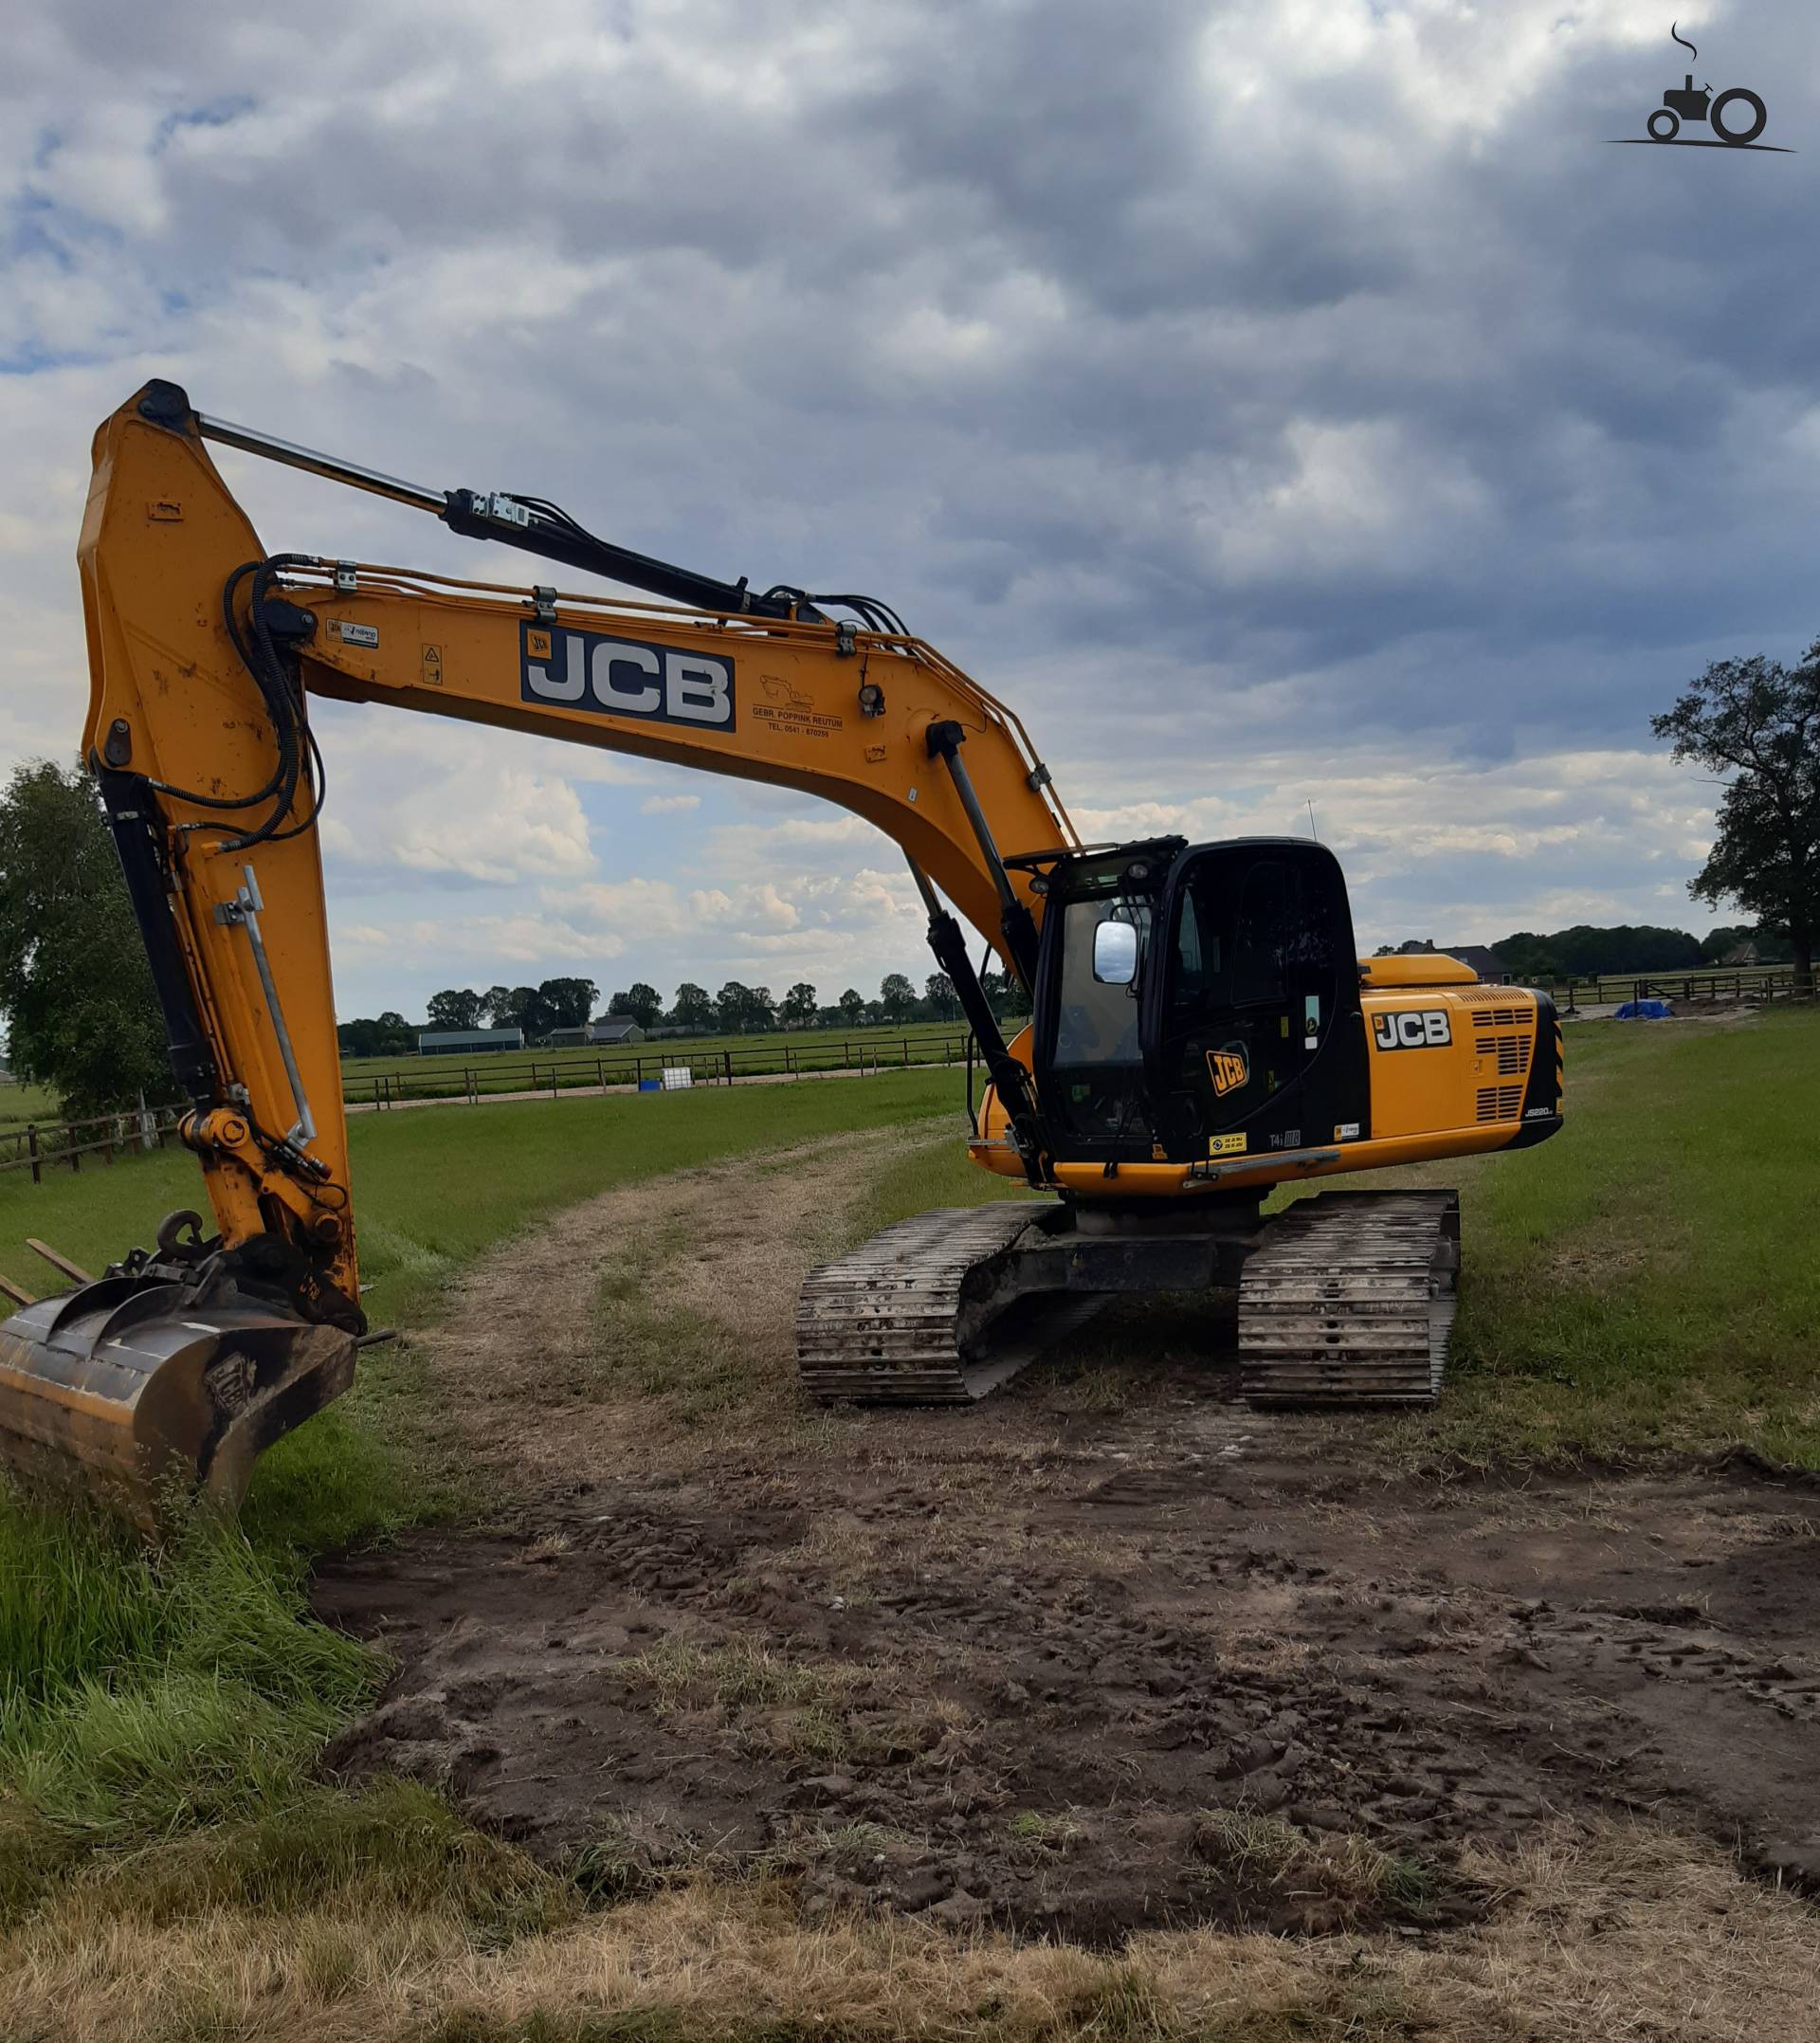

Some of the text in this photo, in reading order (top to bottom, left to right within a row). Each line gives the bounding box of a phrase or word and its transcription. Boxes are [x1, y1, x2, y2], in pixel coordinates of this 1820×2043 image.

[528, 635, 731, 723] JCB
[778, 711, 810, 722] POPPINK
[812, 717, 843, 727] REUTUM
[1376, 1012, 1450, 1049] JCB
[1213, 1055, 1245, 1091] JCB
[211, 1361, 243, 1405] JCB
